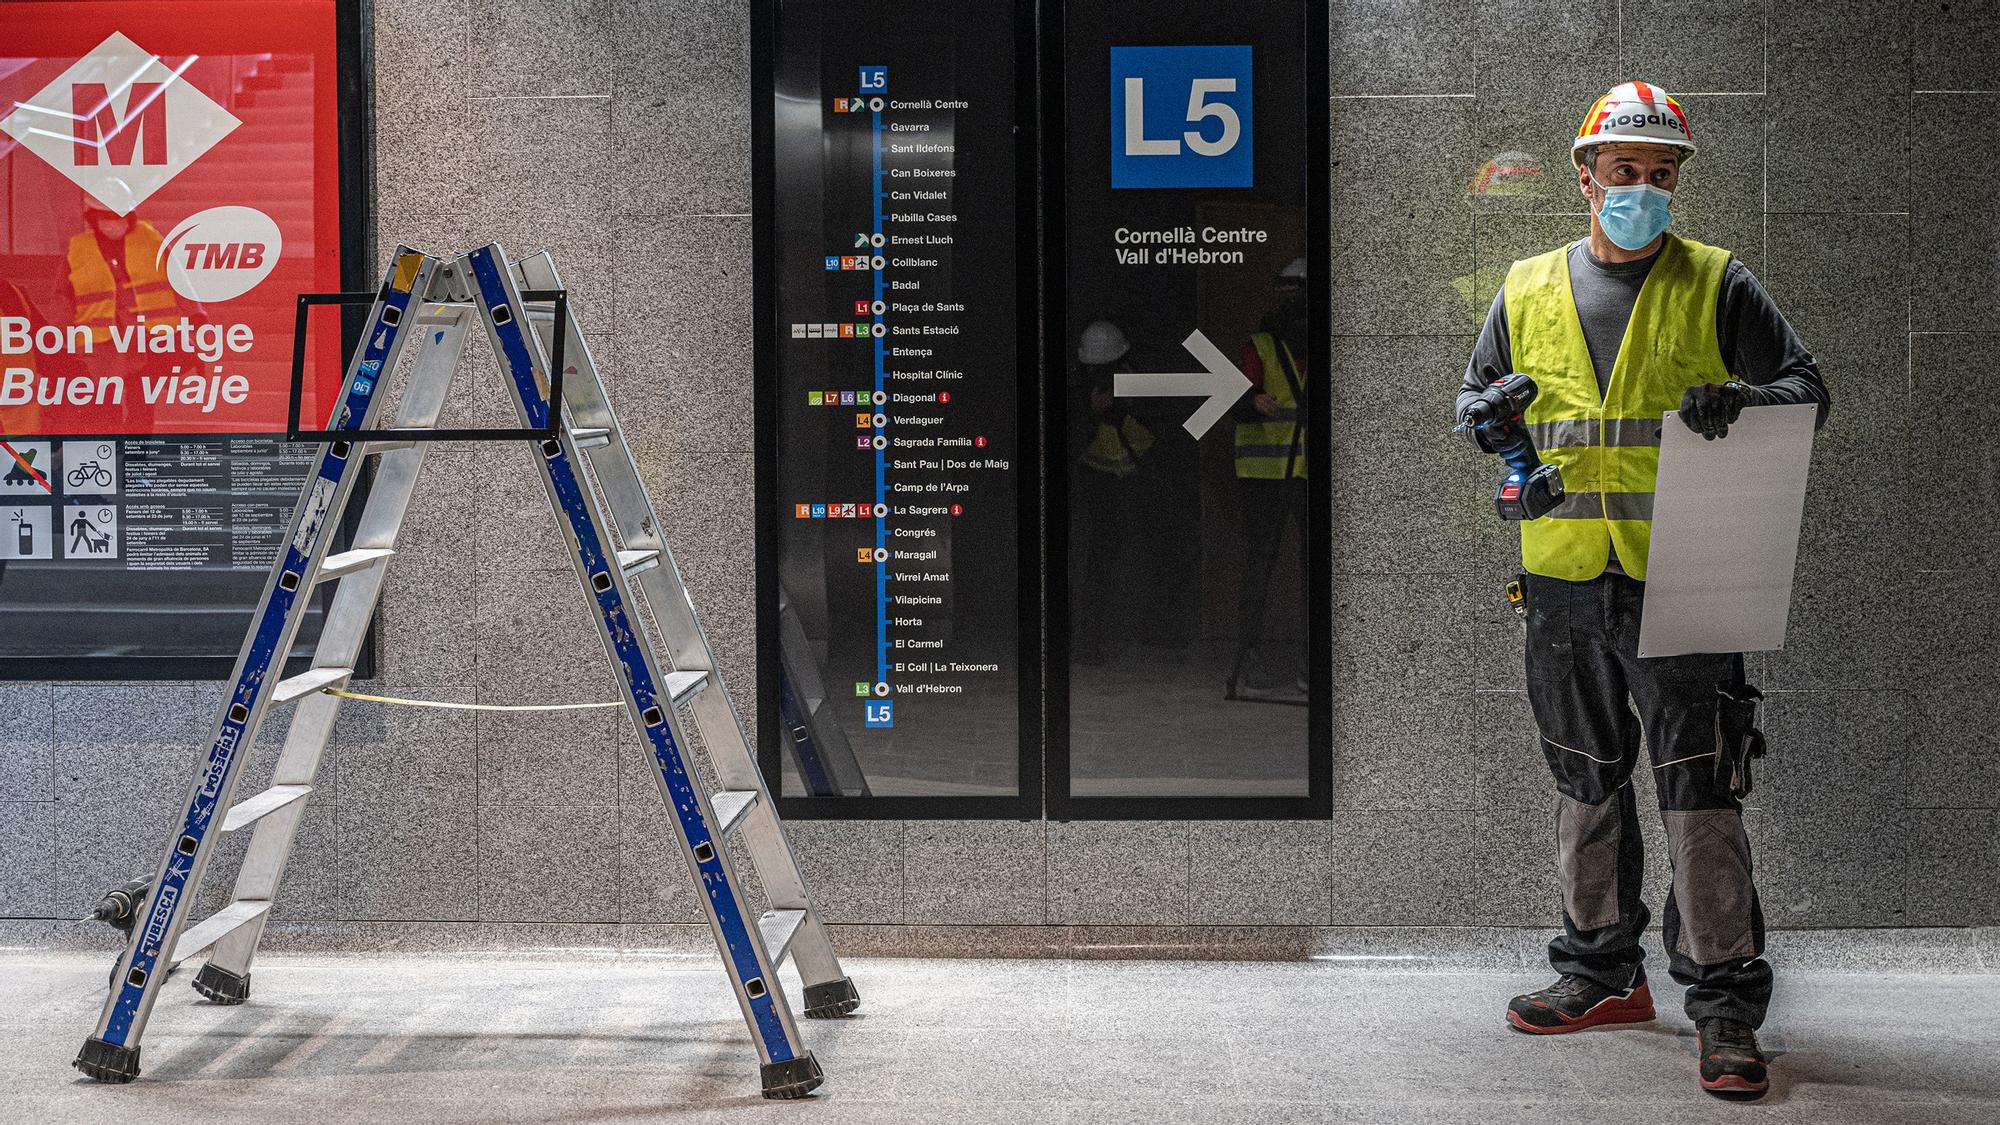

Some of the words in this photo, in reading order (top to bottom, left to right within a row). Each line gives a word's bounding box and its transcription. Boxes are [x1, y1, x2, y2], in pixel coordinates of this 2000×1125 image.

[861, 72, 885, 88] L5
[840, 100, 848, 109] R
[891, 100, 931, 109] Cornellà
[935, 100, 968, 108] Centre
[1125, 78, 1240, 156] L5
[72, 83, 168, 166] M
[891, 123, 929, 131] Gavarra
[1603, 113, 1686, 133] nogales
[917, 144, 954, 152] Ildefons
[892, 169, 910, 177] Can
[914, 169, 955, 177] Boixeres
[892, 191, 910, 199] Can
[914, 191, 946, 199] Vidalet
[892, 214, 924, 222] Pubilla
[927, 213, 957, 221] Cases
[1115, 227, 1195, 243] Cornellà
[1202, 227, 1267, 243] Centre
[892, 236, 923, 244] Ernest
[927, 236, 952, 244] Lluch
[184, 243, 265, 269] TMB
[1116, 249, 1148, 264] Vall
[1156, 248, 1243, 264] d'Hebron
[843, 259, 853, 267] L9
[893, 258, 937, 266] Collblanc
[893, 281, 919, 289] Badal
[858, 304, 867, 312] L1
[893, 303, 919, 313] Plaça
[922, 303, 934, 311] de
[937, 303, 964, 311] Sants
[924, 326, 959, 334] Estació
[1, 317, 97, 354] Bon
[109, 316, 254, 362] viatge
[893, 348, 932, 358] Entença
[893, 371, 932, 380] Hospital
[936, 371, 962, 379] Clínic
[0, 367, 124, 406] Buen
[142, 366, 249, 411] viaje
[826, 394, 837, 402] L7
[842, 394, 853, 402] L6
[858, 394, 869, 402] L3
[894, 394, 935, 403] Diagonal
[894, 416, 943, 426] Verdaguer
[894, 438, 934, 448] Sagrada
[938, 438, 971, 446] Família
[894, 460, 916, 468] Sant
[920, 460, 938, 468] Pau
[947, 460, 966, 468] Dos
[970, 460, 981, 468] de
[985, 460, 1008, 470] Maig
[895, 483, 923, 493] Camp
[926, 483, 937, 491] de
[895, 506, 905, 514] La
[909, 506, 947, 516] Sagrera
[895, 528, 936, 538] Congrés
[895, 551, 936, 560] Maragall
[896, 573, 920, 581] Virrei
[923, 573, 949, 581] Amat
[895, 596, 941, 605] Vilapicina
[896, 640, 904, 648] El
[908, 640, 942, 648] Carmel
[896, 663, 904, 671] El
[908, 663, 926, 671] Coll
[935, 663, 946, 671] La
[950, 663, 998, 671] Teixonera
[857, 685, 868, 693] L3
[897, 685, 913, 693] Vall
[868, 706, 891, 721] L5
